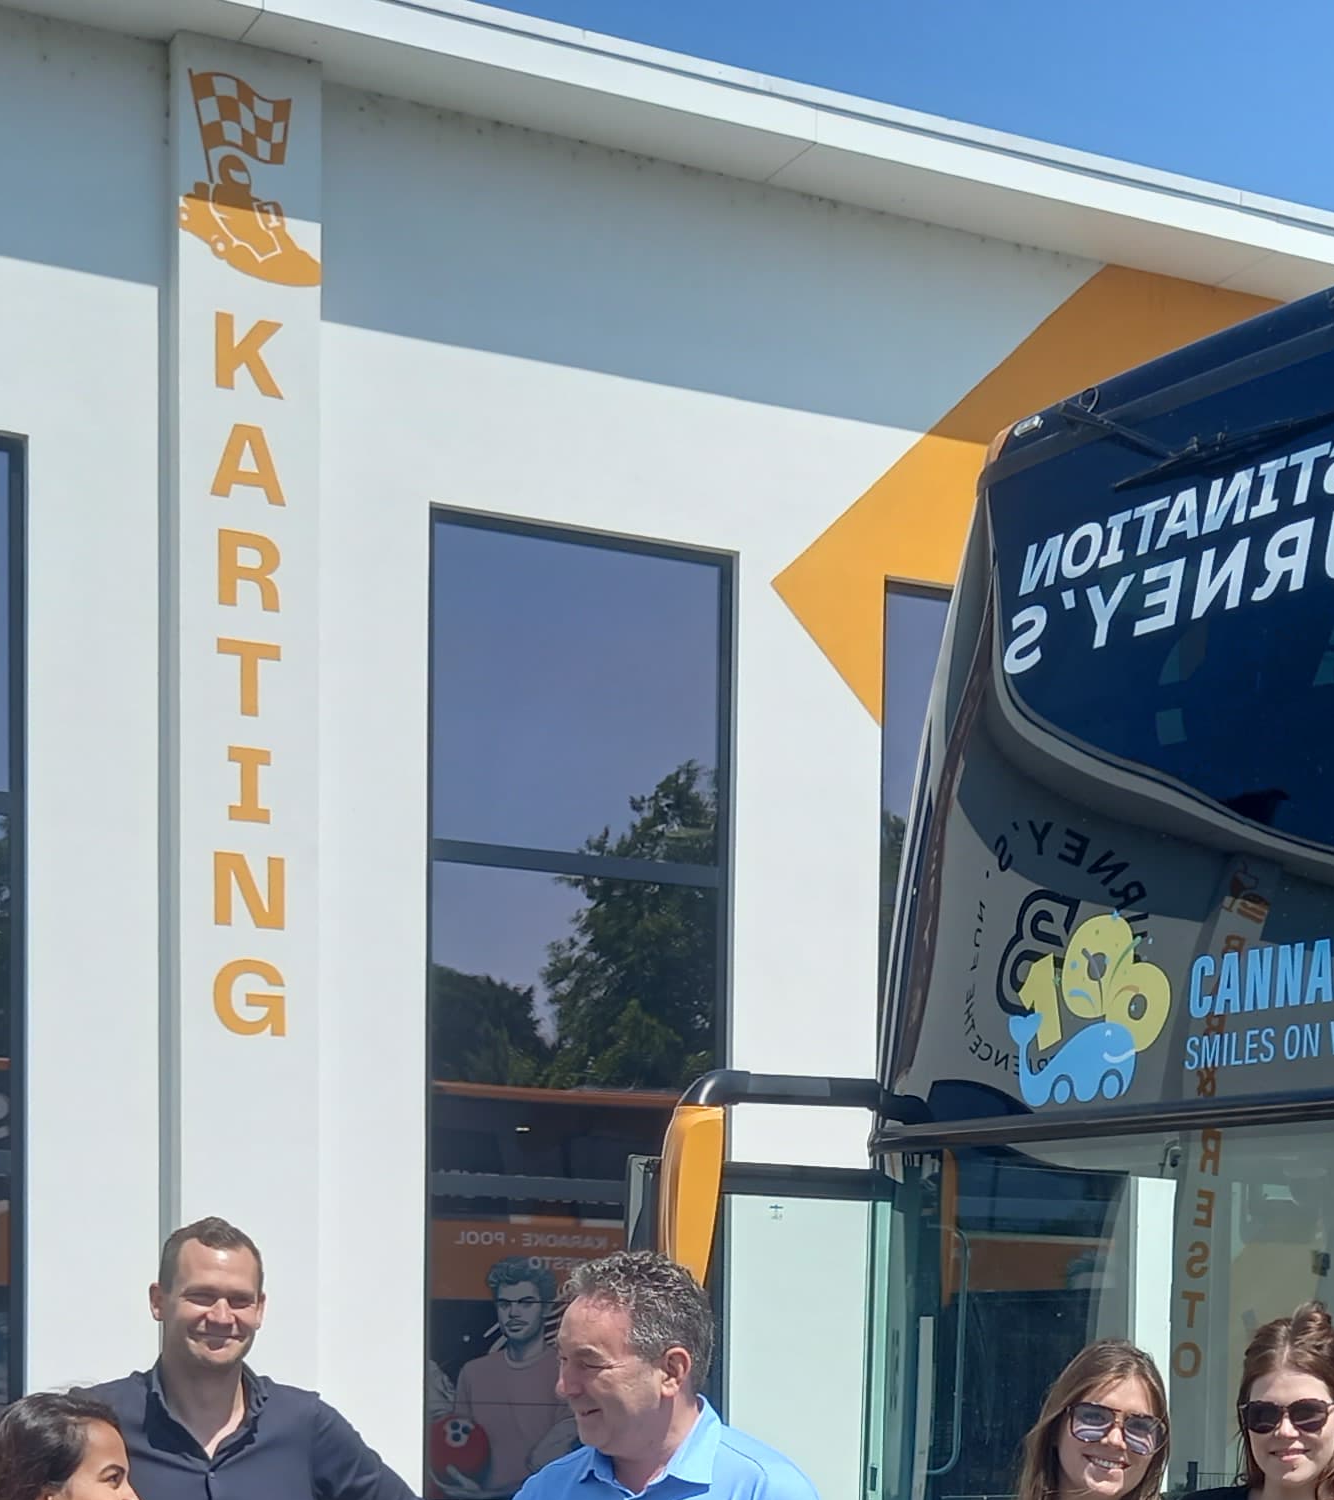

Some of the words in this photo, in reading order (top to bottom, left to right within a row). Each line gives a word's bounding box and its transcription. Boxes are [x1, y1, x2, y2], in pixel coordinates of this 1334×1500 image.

[210, 310, 286, 1036] KARTING
[1185, 1026, 1276, 1071] SMILES
[1283, 1023, 1320, 1061] ON
